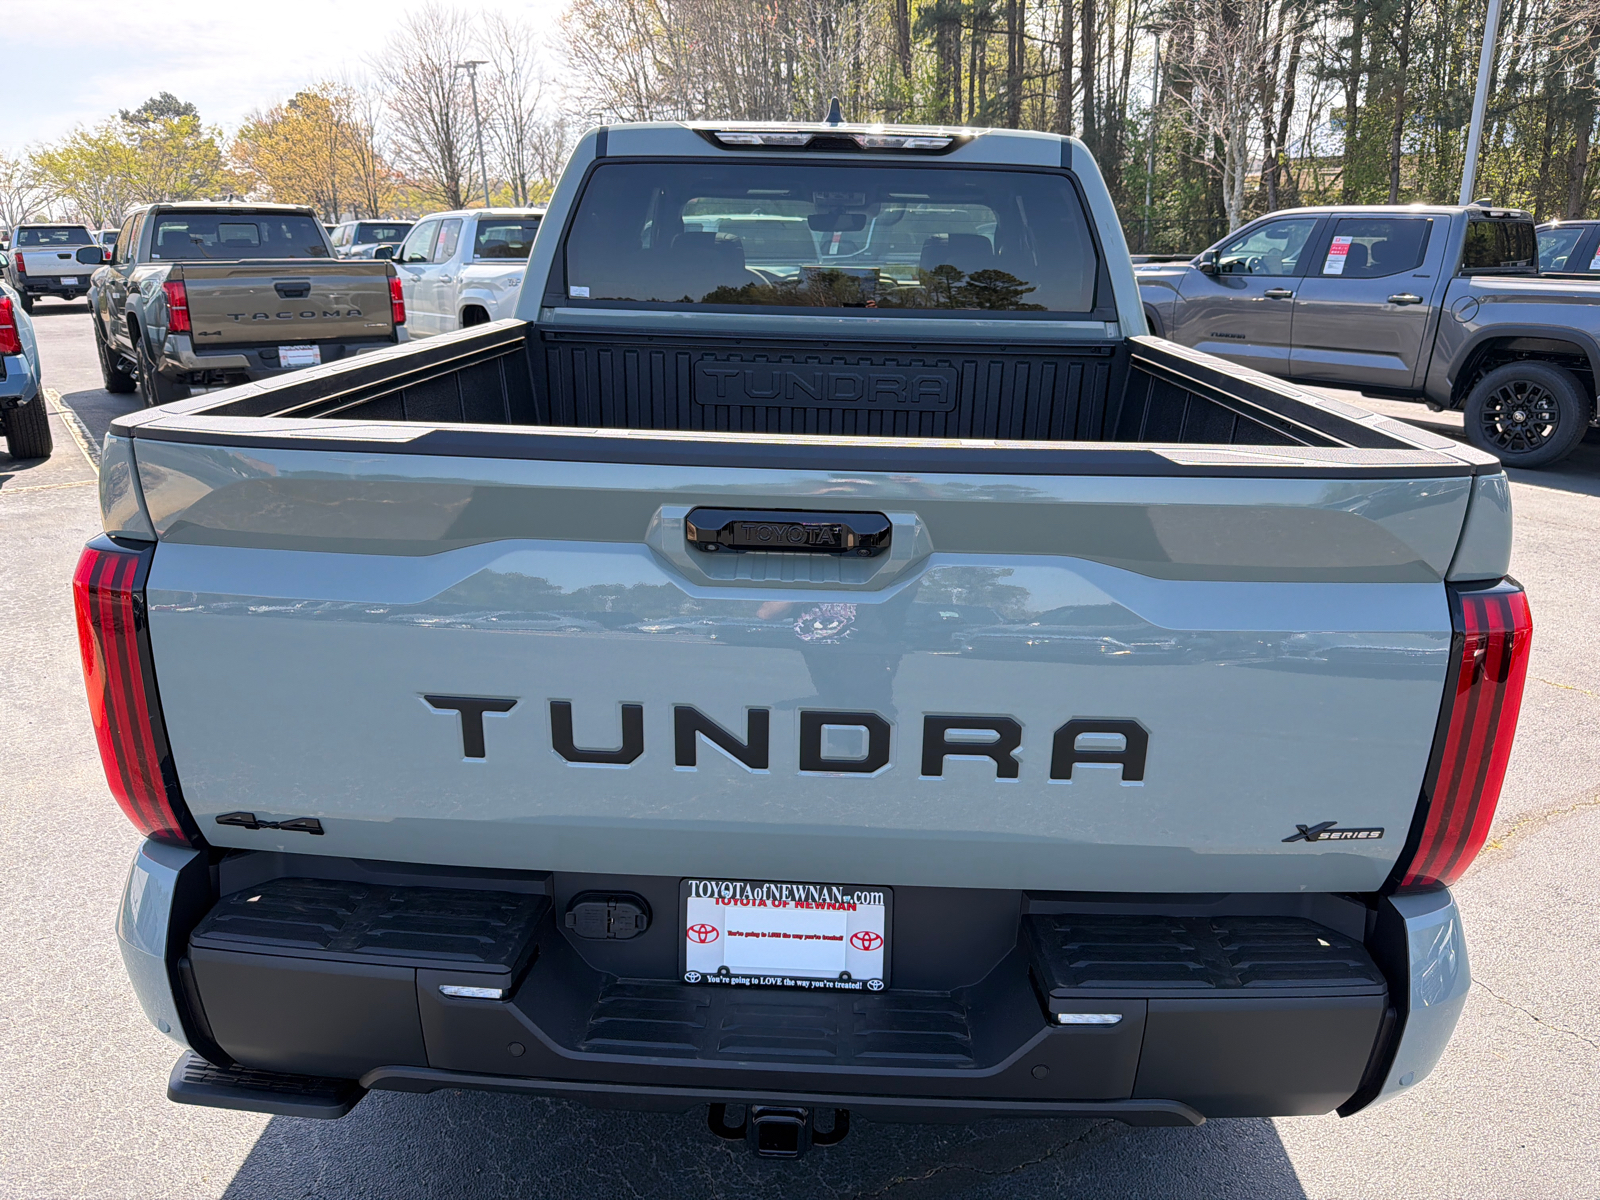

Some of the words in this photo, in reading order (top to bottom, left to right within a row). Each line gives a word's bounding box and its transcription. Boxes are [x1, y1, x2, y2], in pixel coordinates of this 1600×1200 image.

[227, 309, 363, 322] TACOMA
[702, 368, 949, 404] TUNDRA
[740, 523, 836, 545] TOYOTA
[420, 694, 1150, 786] TUNDRA
[707, 975, 730, 983] You're
[731, 976, 750, 985] going
[760, 977, 782, 985] LOVE
[784, 978, 795, 986] the
[796, 980, 810, 988] way
[811, 980, 833, 988] you're
